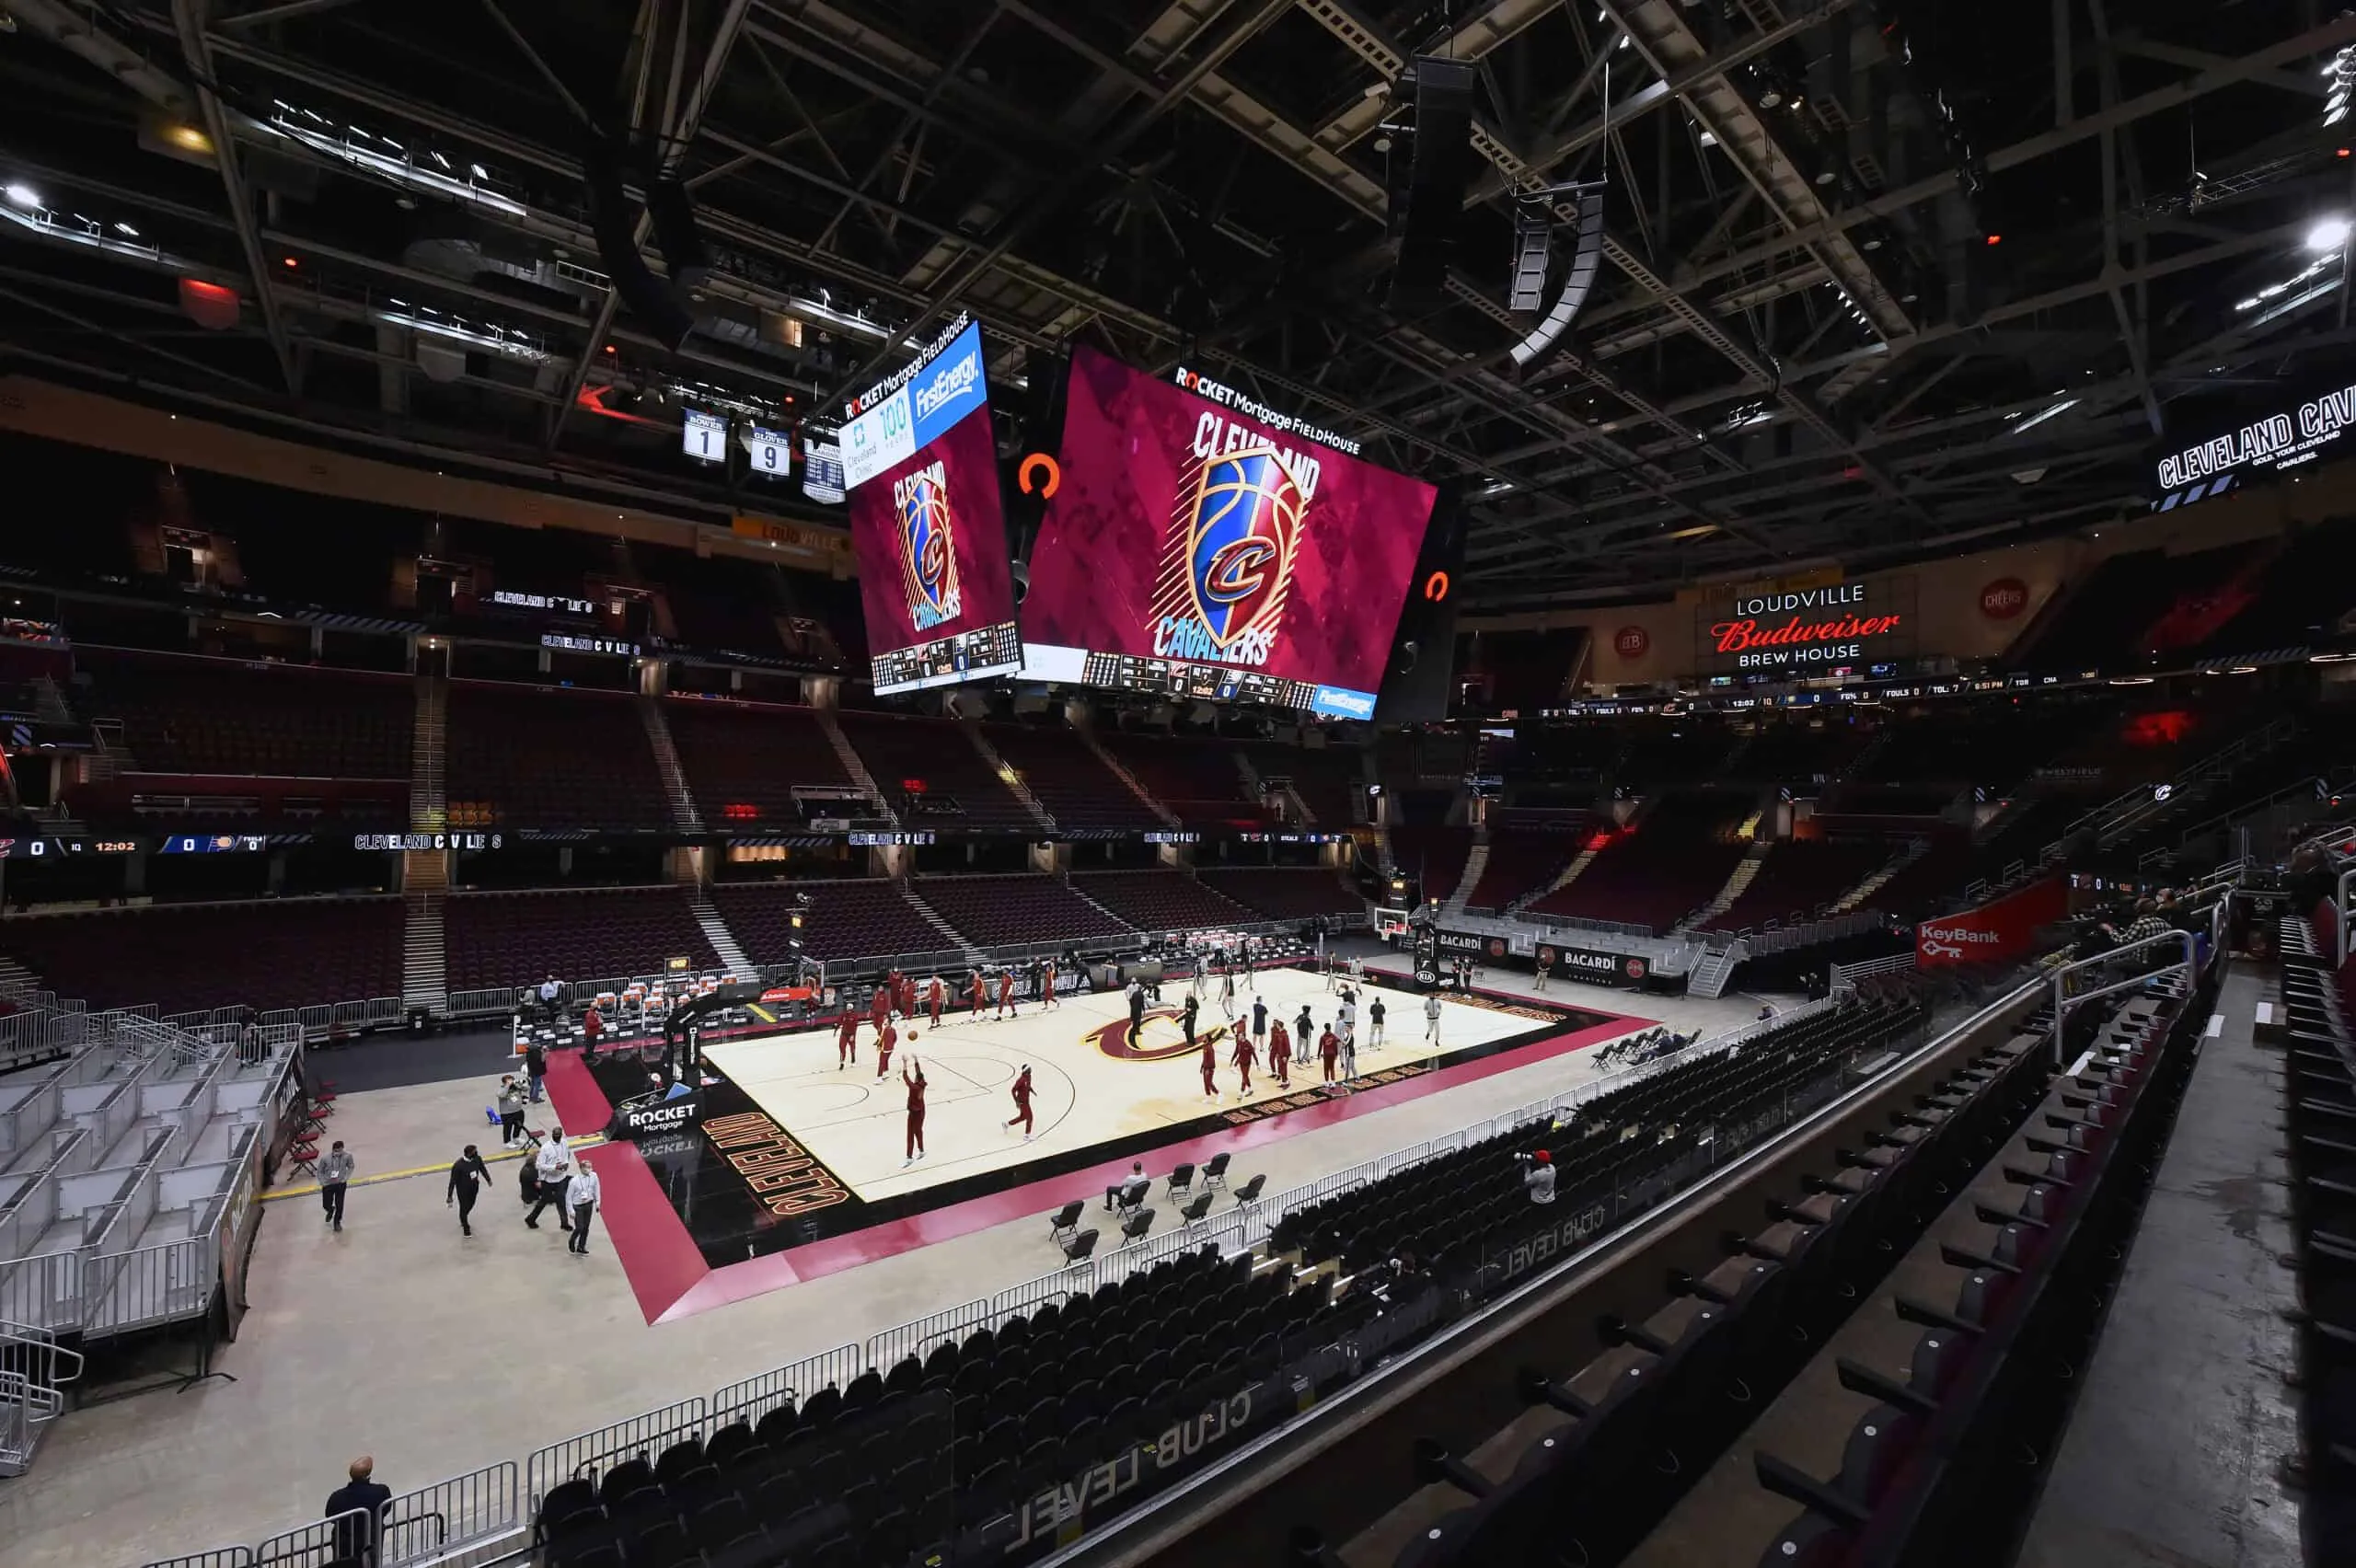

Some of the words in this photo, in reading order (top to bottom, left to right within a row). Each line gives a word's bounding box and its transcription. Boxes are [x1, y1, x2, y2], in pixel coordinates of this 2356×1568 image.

[845, 386, 884, 421] ROCKET
[884, 357, 924, 395] Mortgage
[1175, 366, 1234, 405] ROCKET
[1233, 392, 1292, 432] Mortgage
[700, 431, 710, 455] 1
[2158, 413, 2293, 490] CLEVELAND
[2299, 385, 2356, 437] CAV
[764, 446, 778, 469] 9
[1193, 411, 1321, 501] CLEAND
[1737, 585, 1864, 616] LOUDVILLE
[1711, 612, 1900, 654] Budweiser
[1739, 651, 1789, 667] BREW
[1796, 644, 1861, 663] HOUSE
[1174, 678, 1184, 692] 0
[1887, 688, 1910, 698] FOULS
[30, 842, 45, 856] 0
[95, 842, 136, 853] 12:02
[183, 838, 196, 852] 0
[354, 834, 432, 849] CLEVELAND
[1439, 934, 1483, 951] BACARDÍ
[1921, 926, 2000, 943] KeyBank
[1565, 951, 1618, 972] BACARDÍ
[1419, 972, 1433, 981] KIA
[629, 1103, 697, 1127] ROCKET
[643, 1119, 683, 1133] Mortgage
[701, 1112, 849, 1216] CLEVELAND
